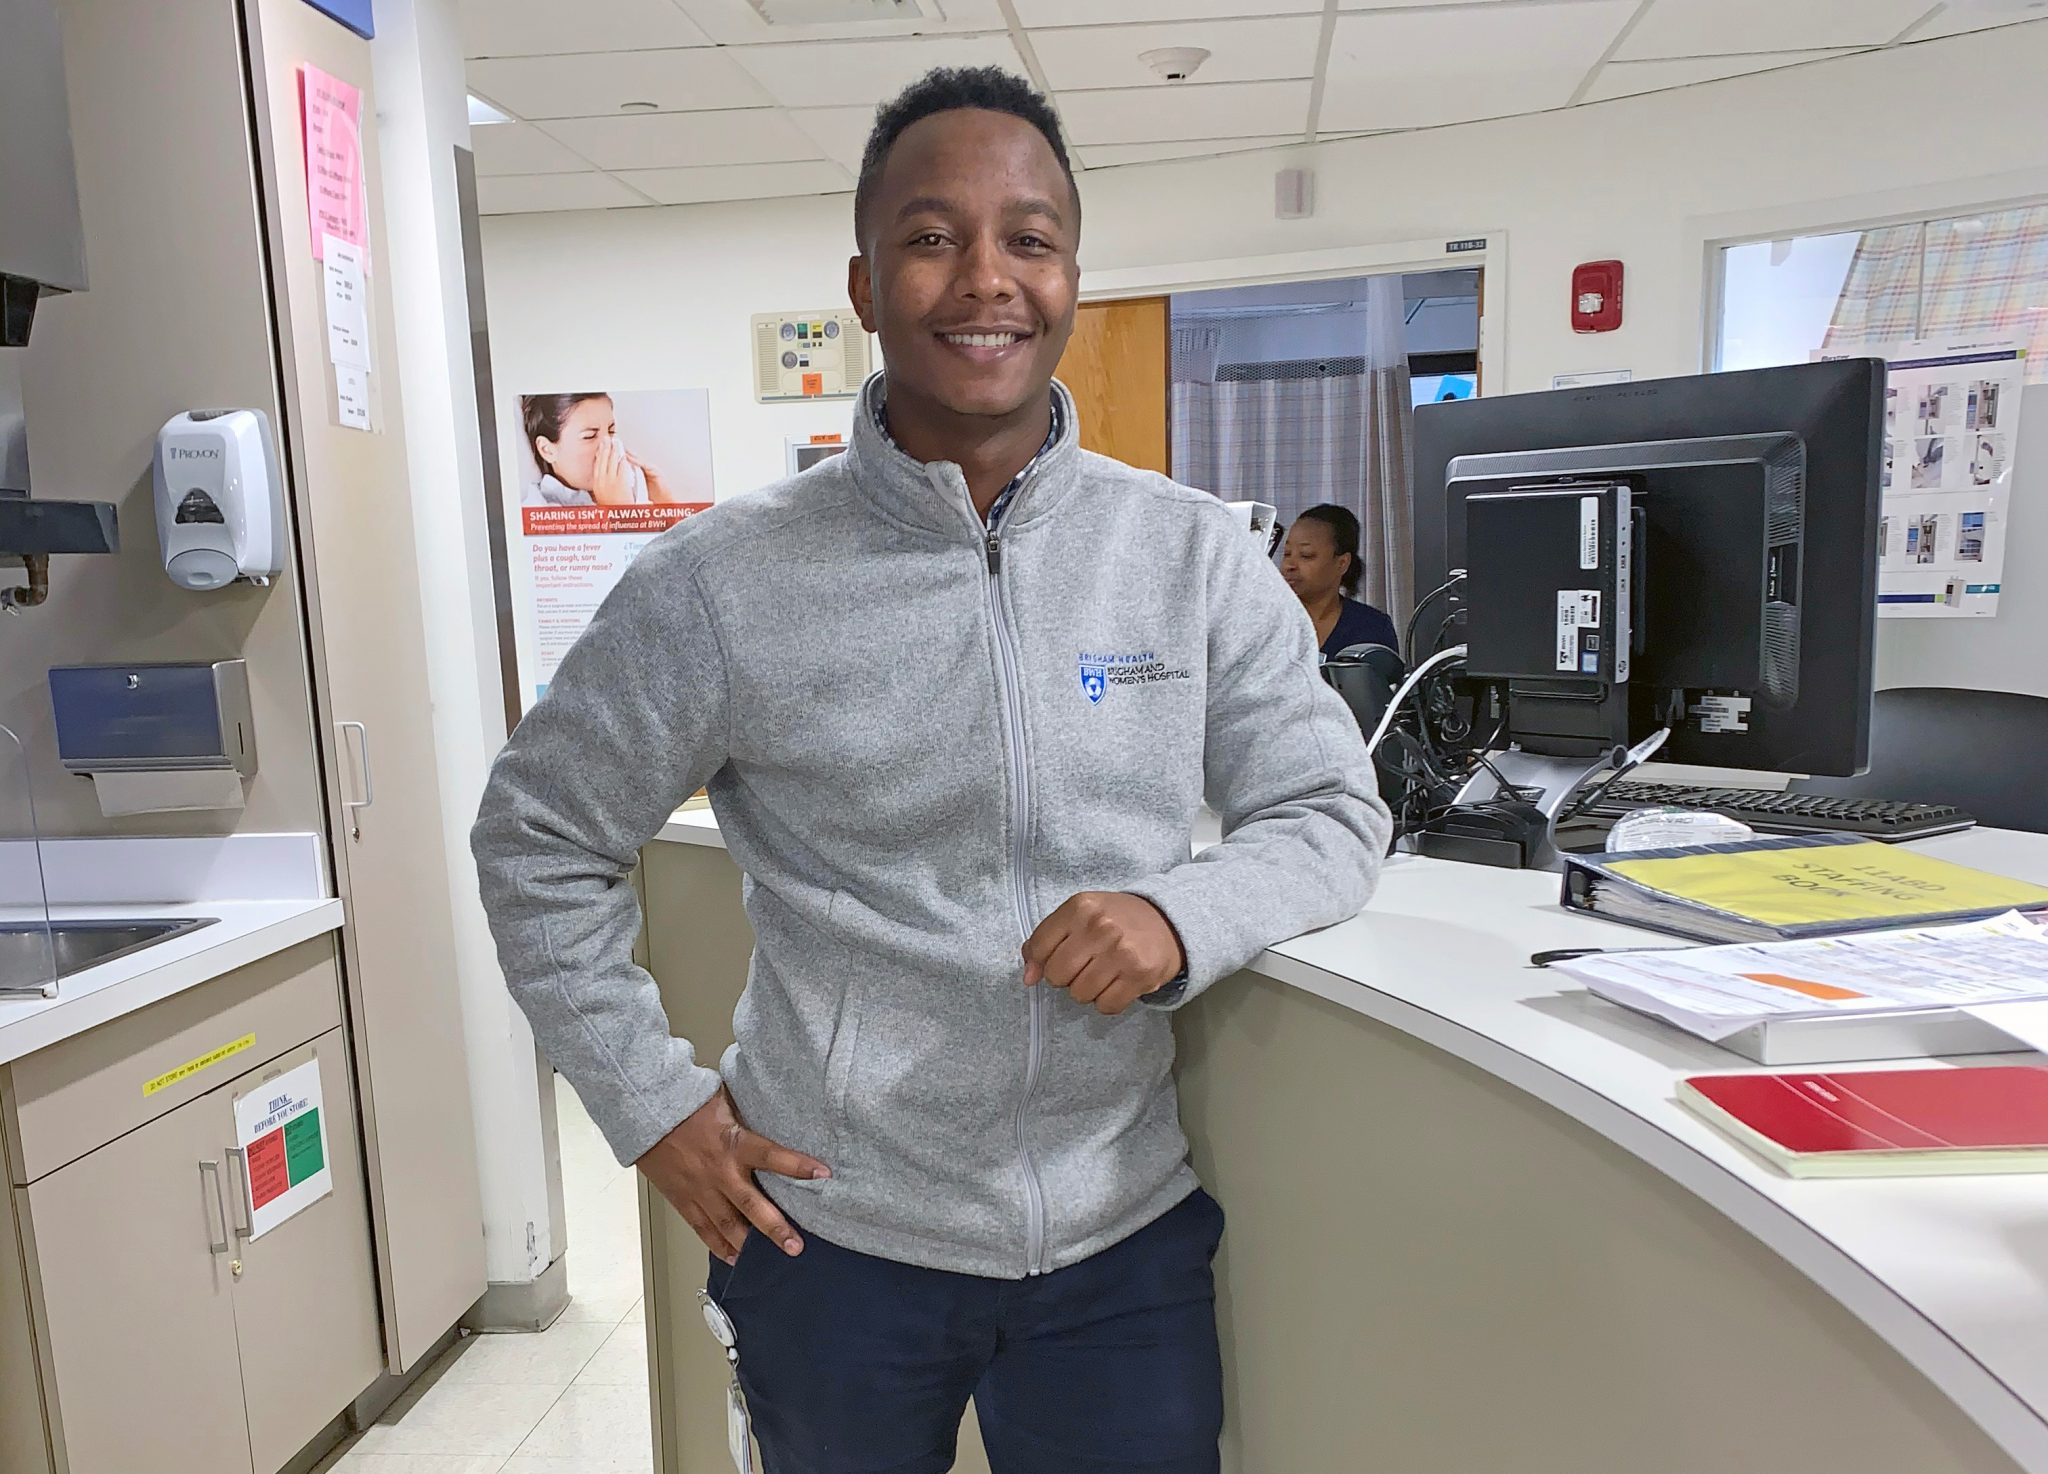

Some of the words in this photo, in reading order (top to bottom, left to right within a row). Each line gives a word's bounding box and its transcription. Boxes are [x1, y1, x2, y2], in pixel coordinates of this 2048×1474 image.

[179, 449, 219, 460] PROVON
[530, 510, 575, 521] SHARING
[578, 509, 604, 520] ISN'T
[607, 508, 651, 519] ALWAYS
[530, 522, 565, 532] Preventing
[566, 522, 577, 530] the
[578, 521, 600, 531] spread
[600, 521, 608, 530] of
[609, 521, 639, 530] influenza
[648, 520, 667, 529] BWH
[533, 544, 543, 552] Do
[544, 545, 557, 554] you
[558, 544, 576, 552] have
[583, 544, 601, 552] fever
[533, 554, 549, 564] plus
[556, 553, 579, 563] cough,
[534, 563, 559, 572] throat,
[569, 564, 590, 573] runny
[592, 563, 613, 571] nose?
[1119, 652, 1154, 663] HEALTH
[1144, 663, 1164, 674] AND
[1148, 670, 1190, 682] HOSPITAL
[1792, 862, 1924, 901] STAFFING
[254, 1114, 276, 1134] BEFORE
[277, 1109, 287, 1122] YOU
